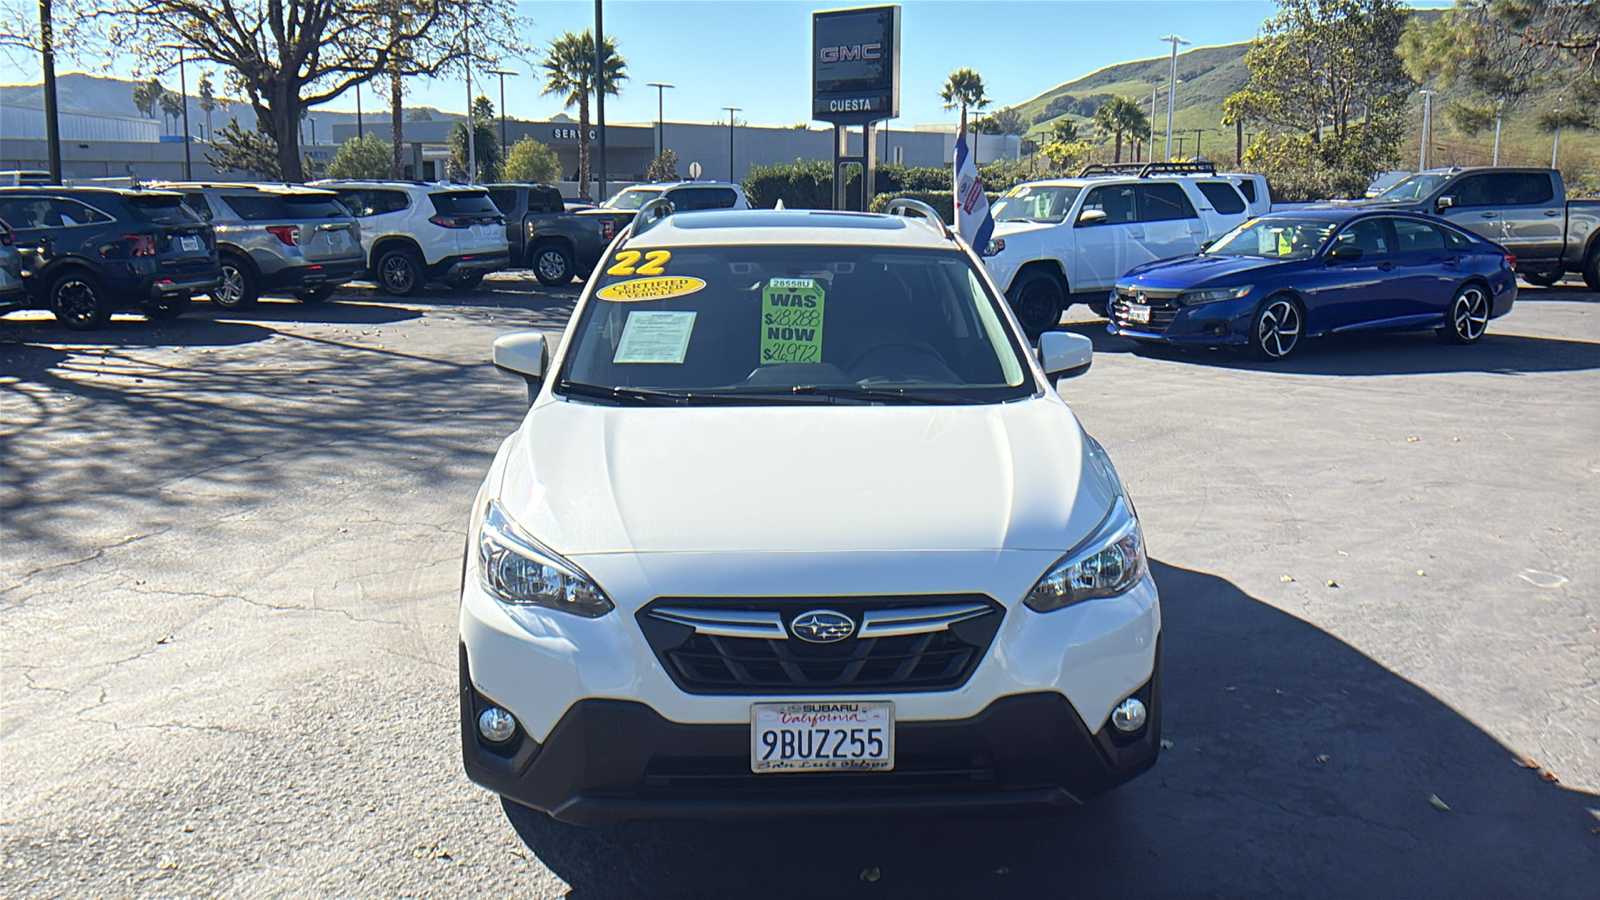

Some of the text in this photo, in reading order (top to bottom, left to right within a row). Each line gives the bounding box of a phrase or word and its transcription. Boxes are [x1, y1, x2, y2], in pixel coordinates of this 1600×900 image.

[820, 43, 881, 63] GMC
[830, 98, 871, 112] CUESTA
[606, 250, 672, 276] 22
[612, 279, 689, 292] CERTIFIED
[618, 285, 683, 296] PRE-OWNED
[627, 290, 674, 299] VEHICLE
[769, 293, 817, 308] WAS
[764, 309, 821, 327] $28,288
[767, 327, 816, 342] NOW
[763, 342, 818, 363] $26,972
[803, 704, 859, 713] SUBARU
[781, 712, 868, 727] California
[762, 728, 883, 760] 9BUZ255
